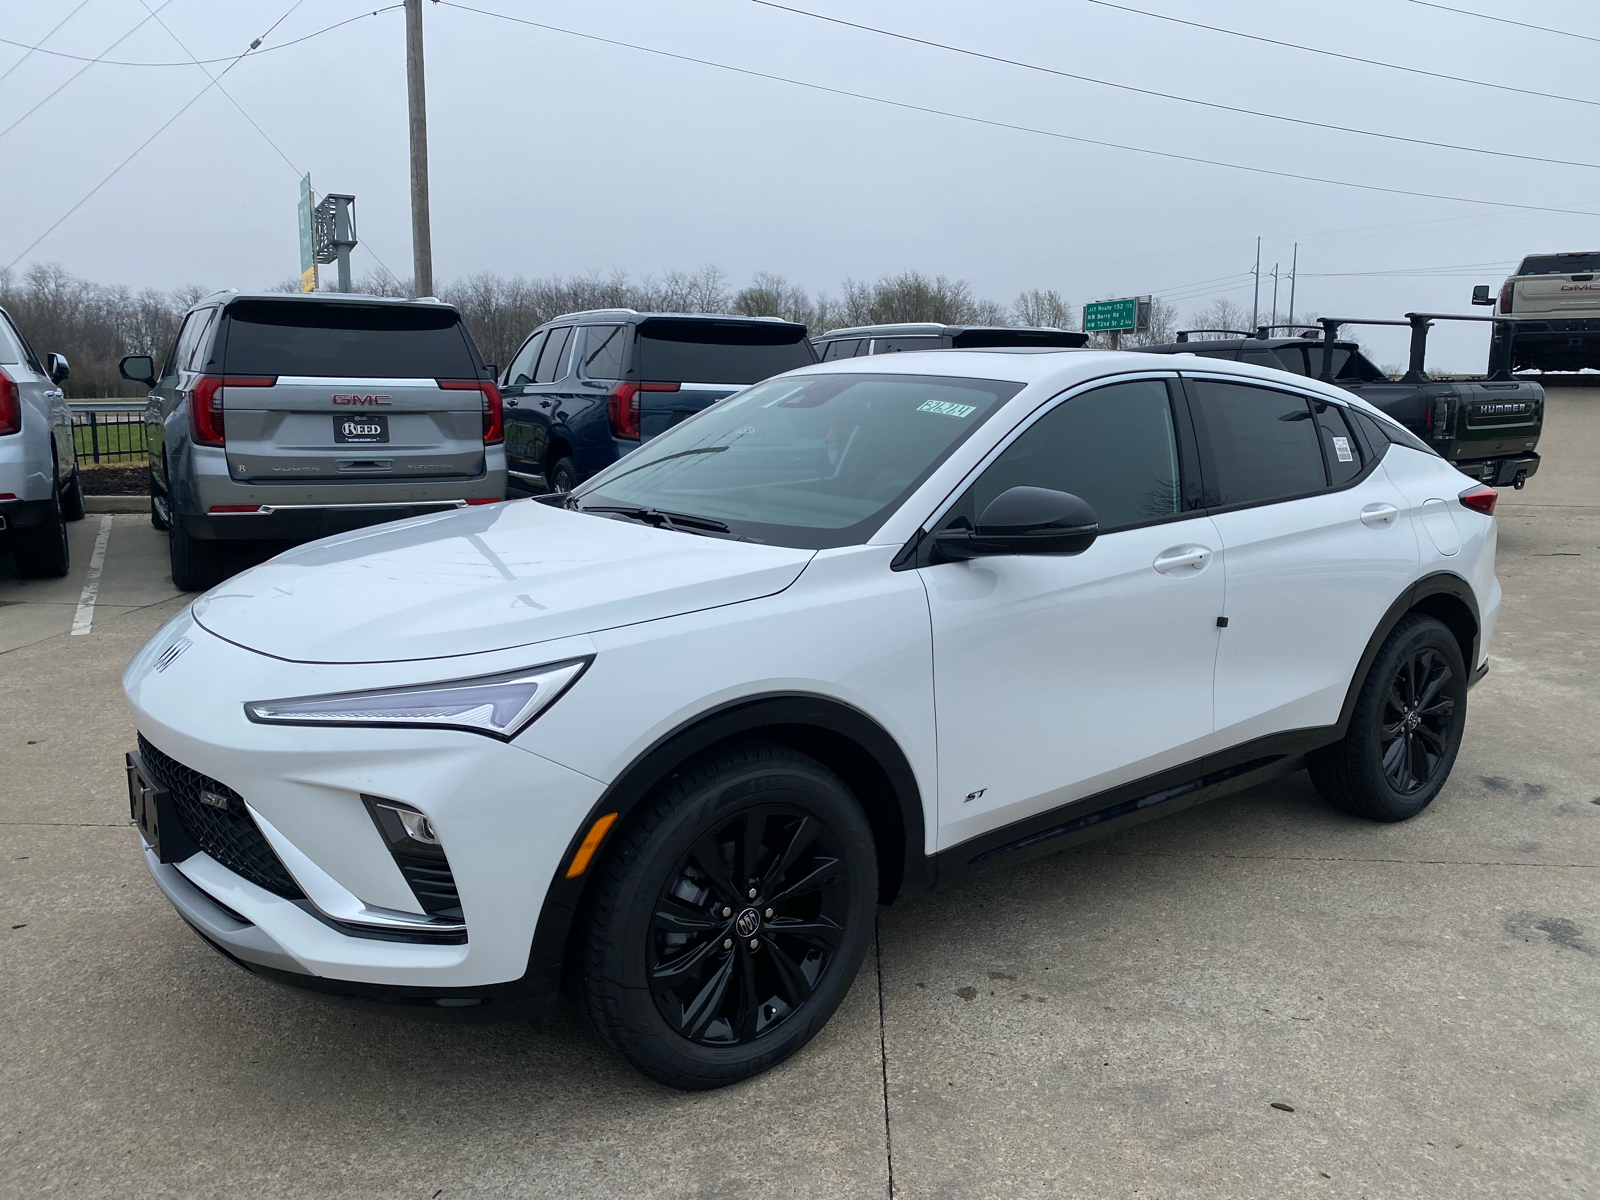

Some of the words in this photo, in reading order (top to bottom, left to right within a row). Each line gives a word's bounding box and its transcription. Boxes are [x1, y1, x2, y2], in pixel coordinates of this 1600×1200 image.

[332, 394, 392, 406] GMC
[1480, 403, 1526, 414] HUMMER
[341, 421, 381, 437] REED
[962, 787, 987, 803] ST
